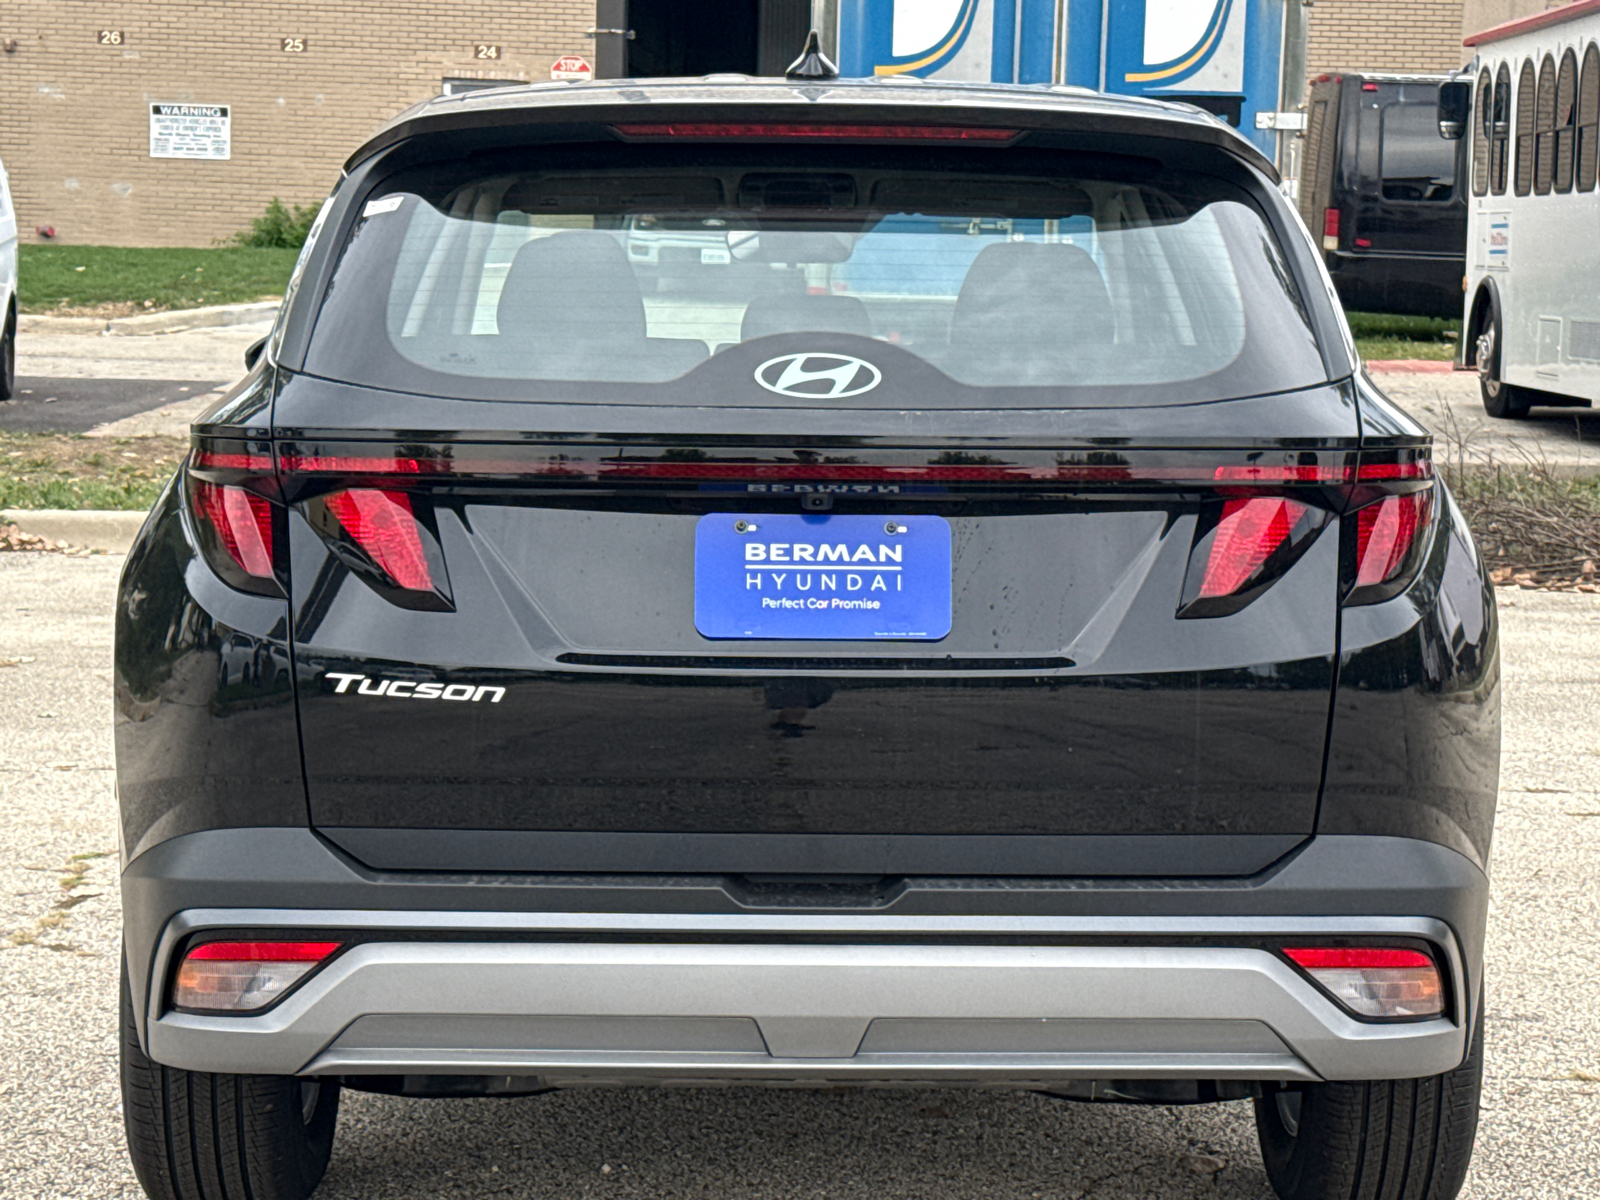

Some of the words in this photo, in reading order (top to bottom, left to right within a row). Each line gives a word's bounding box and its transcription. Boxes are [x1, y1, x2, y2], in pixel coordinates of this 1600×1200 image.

[101, 30, 121, 45] 26
[284, 38, 304, 52] 25
[477, 45, 498, 59] 24
[560, 59, 583, 71] STOP
[159, 106, 221, 117] WARNING
[745, 543, 903, 562] BERMAN
[746, 572, 902, 591] HYUNDAI
[762, 597, 805, 609] Perfect
[807, 597, 829, 609] Car
[831, 597, 881, 610] Promise
